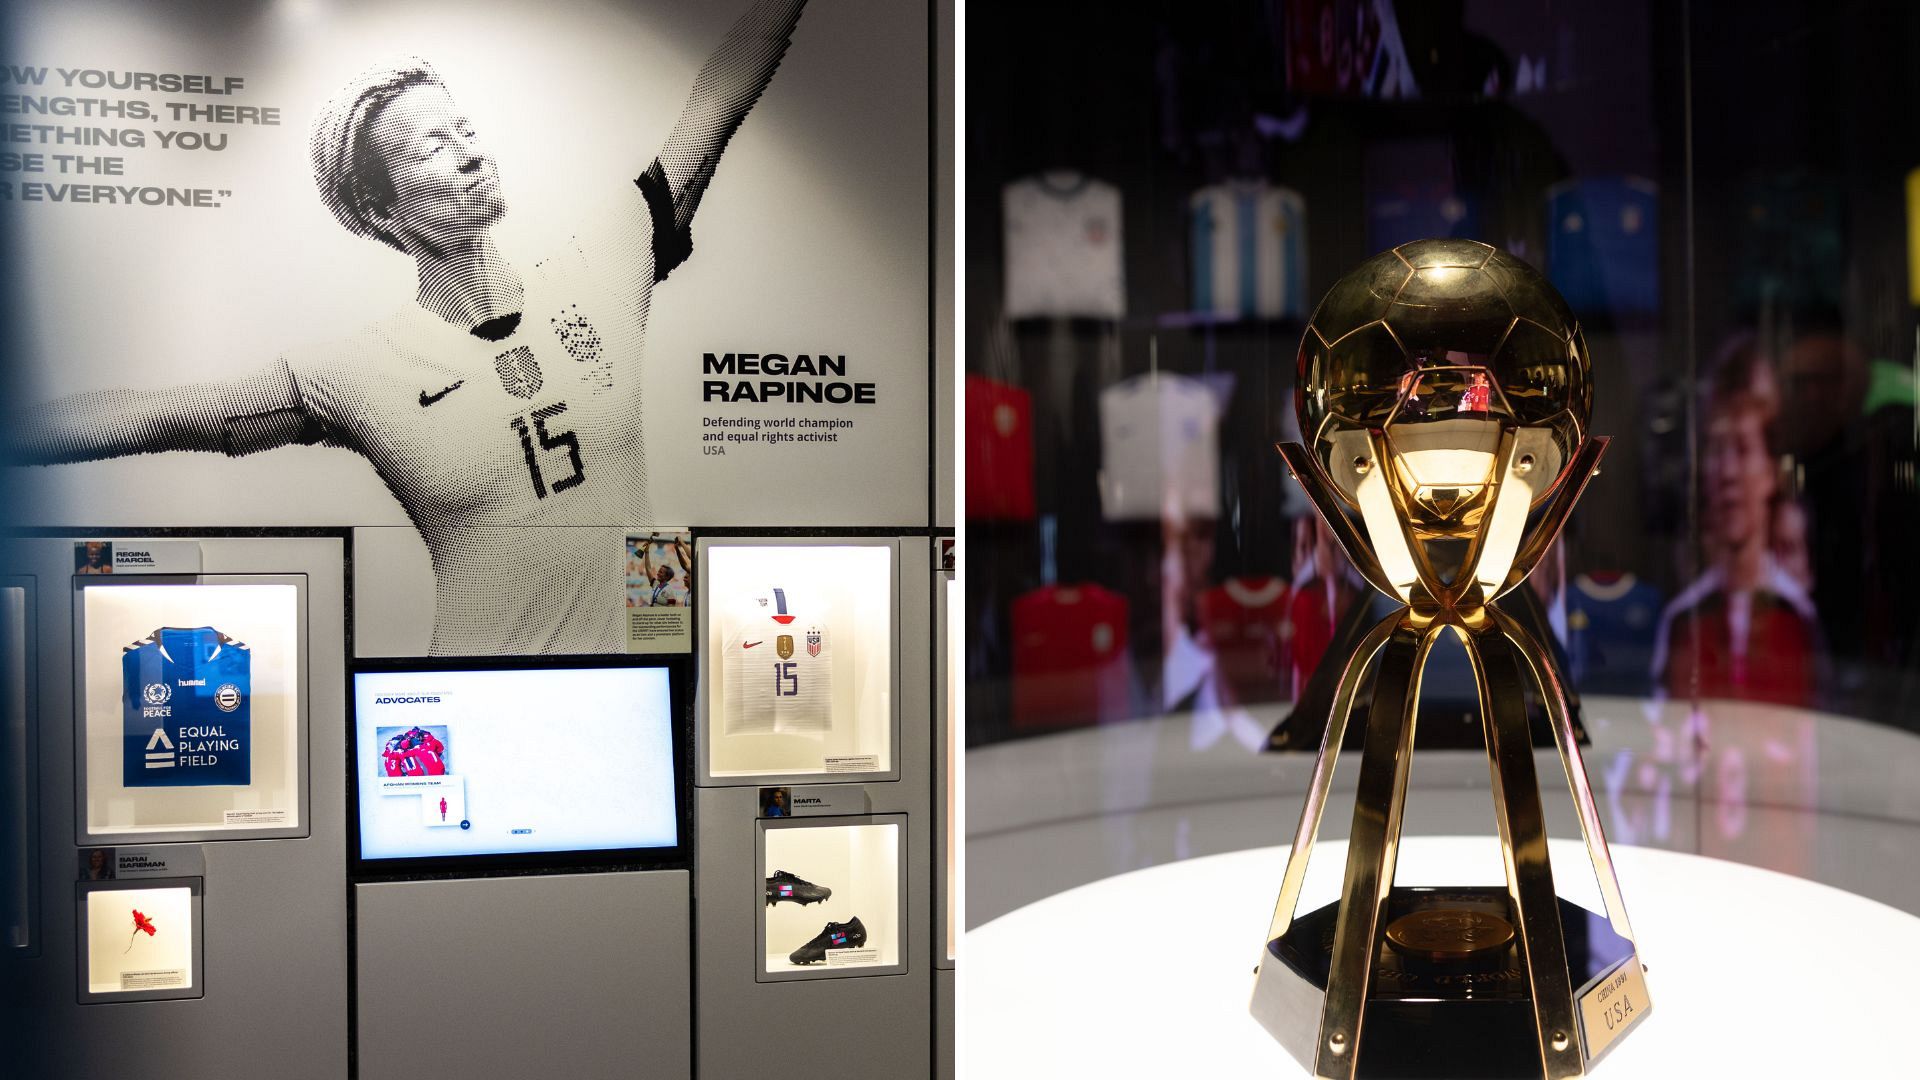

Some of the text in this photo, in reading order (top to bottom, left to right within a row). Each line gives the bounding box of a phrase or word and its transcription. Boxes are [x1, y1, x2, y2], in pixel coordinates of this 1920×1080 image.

[56, 68, 244, 95] YOURSELF
[0, 94, 281, 125] ENGTHS, THERE
[0, 123, 228, 151] ETHING YOU
[0, 152, 124, 176] SE THE
[702, 353, 846, 377] MEGAN
[702, 381, 876, 404] RAPINOE
[703, 417, 854, 431] Defending world champion
[702, 431, 838, 444] and equal rights activist
[511, 401, 585, 499] 15
[703, 445, 726, 456] USA
[178, 678, 206, 687] hummel
[774, 663, 798, 697] 15
[375, 696, 441, 705] ADVOCATES
[143, 709, 172, 717] PEACE
[179, 726, 227, 738] EQUAL
[179, 739, 240, 753] PLAYING
[180, 754, 218, 767] FIELD
[1597, 983, 1616, 1003] CHINA
[1603, 994, 1634, 1031] USA
